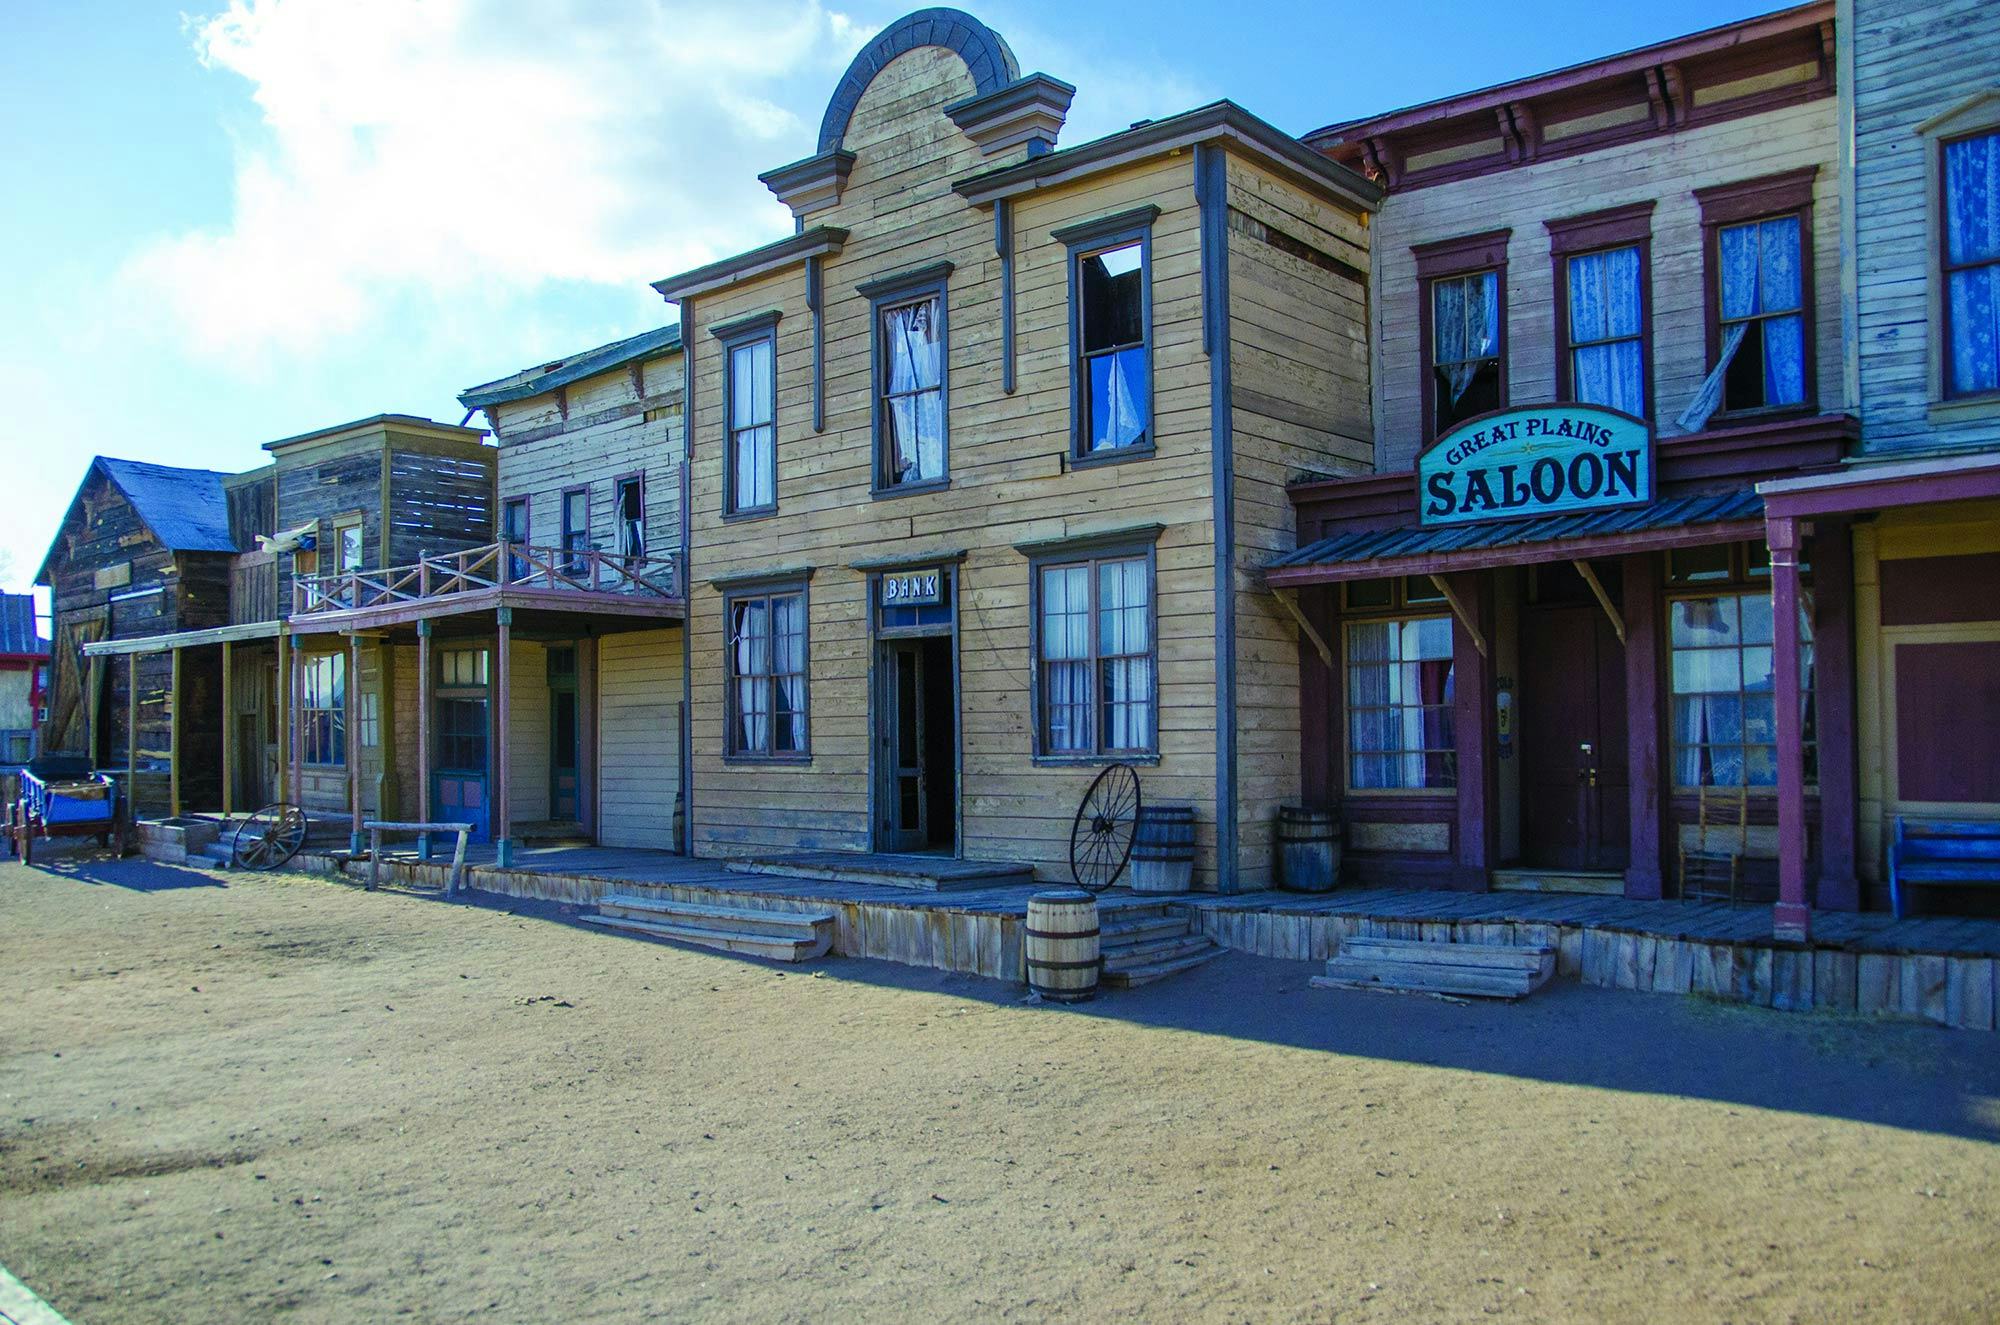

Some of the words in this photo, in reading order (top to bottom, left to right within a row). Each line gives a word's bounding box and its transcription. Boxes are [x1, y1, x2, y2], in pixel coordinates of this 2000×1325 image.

[1446, 421, 1520, 466] GREAT
[1526, 418, 1613, 448] PLAINS
[1426, 449, 1641, 517] SALOON
[886, 575, 936, 600] BANK
